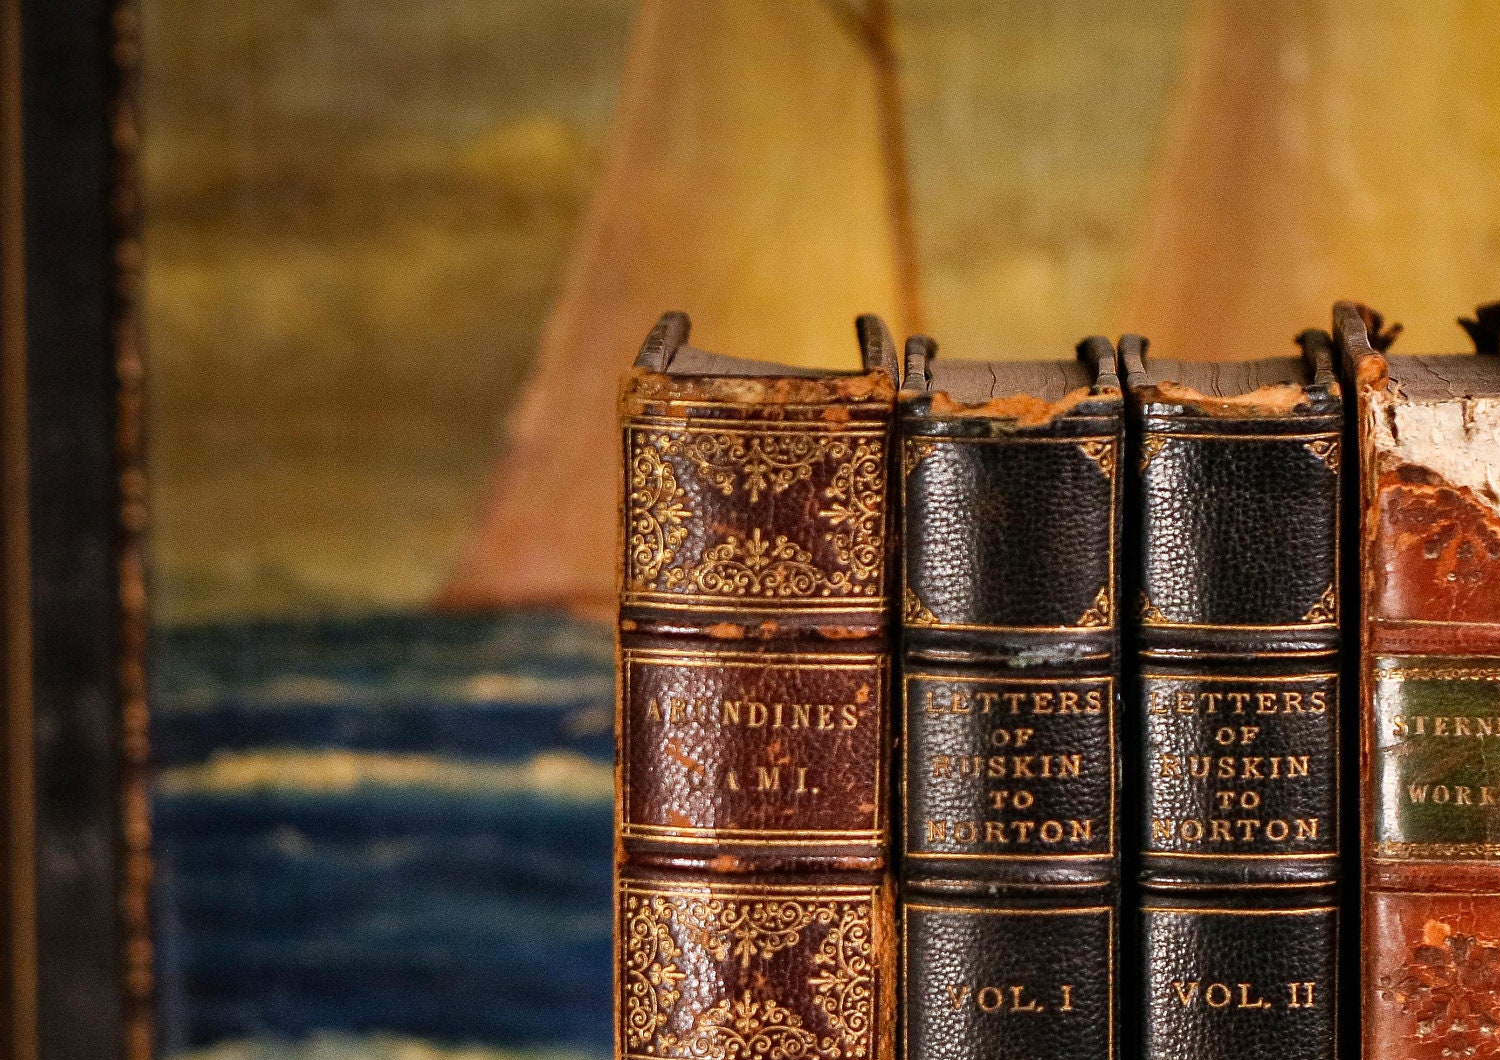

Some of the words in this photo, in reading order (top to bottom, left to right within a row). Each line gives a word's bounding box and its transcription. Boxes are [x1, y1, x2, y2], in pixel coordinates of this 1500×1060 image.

[924, 690, 1102, 715] LETTERS
[1149, 690, 1328, 715] LETTERS
[992, 727, 1035, 748] OF
[1215, 726, 1261, 746] OF
[932, 753, 1083, 779] RUSKIN
[1159, 753, 1311, 779] RUSKIN
[988, 790, 1035, 810] TO
[1215, 790, 1261, 810] TO
[925, 818, 1094, 844] NORTON
[1152, 817, 1320, 843] NORTON
[946, 983, 1044, 1013] VOL.
[1060, 984, 1074, 1011] I
[1173, 981, 1272, 1010] VOL.
[1288, 981, 1317, 1009] II
